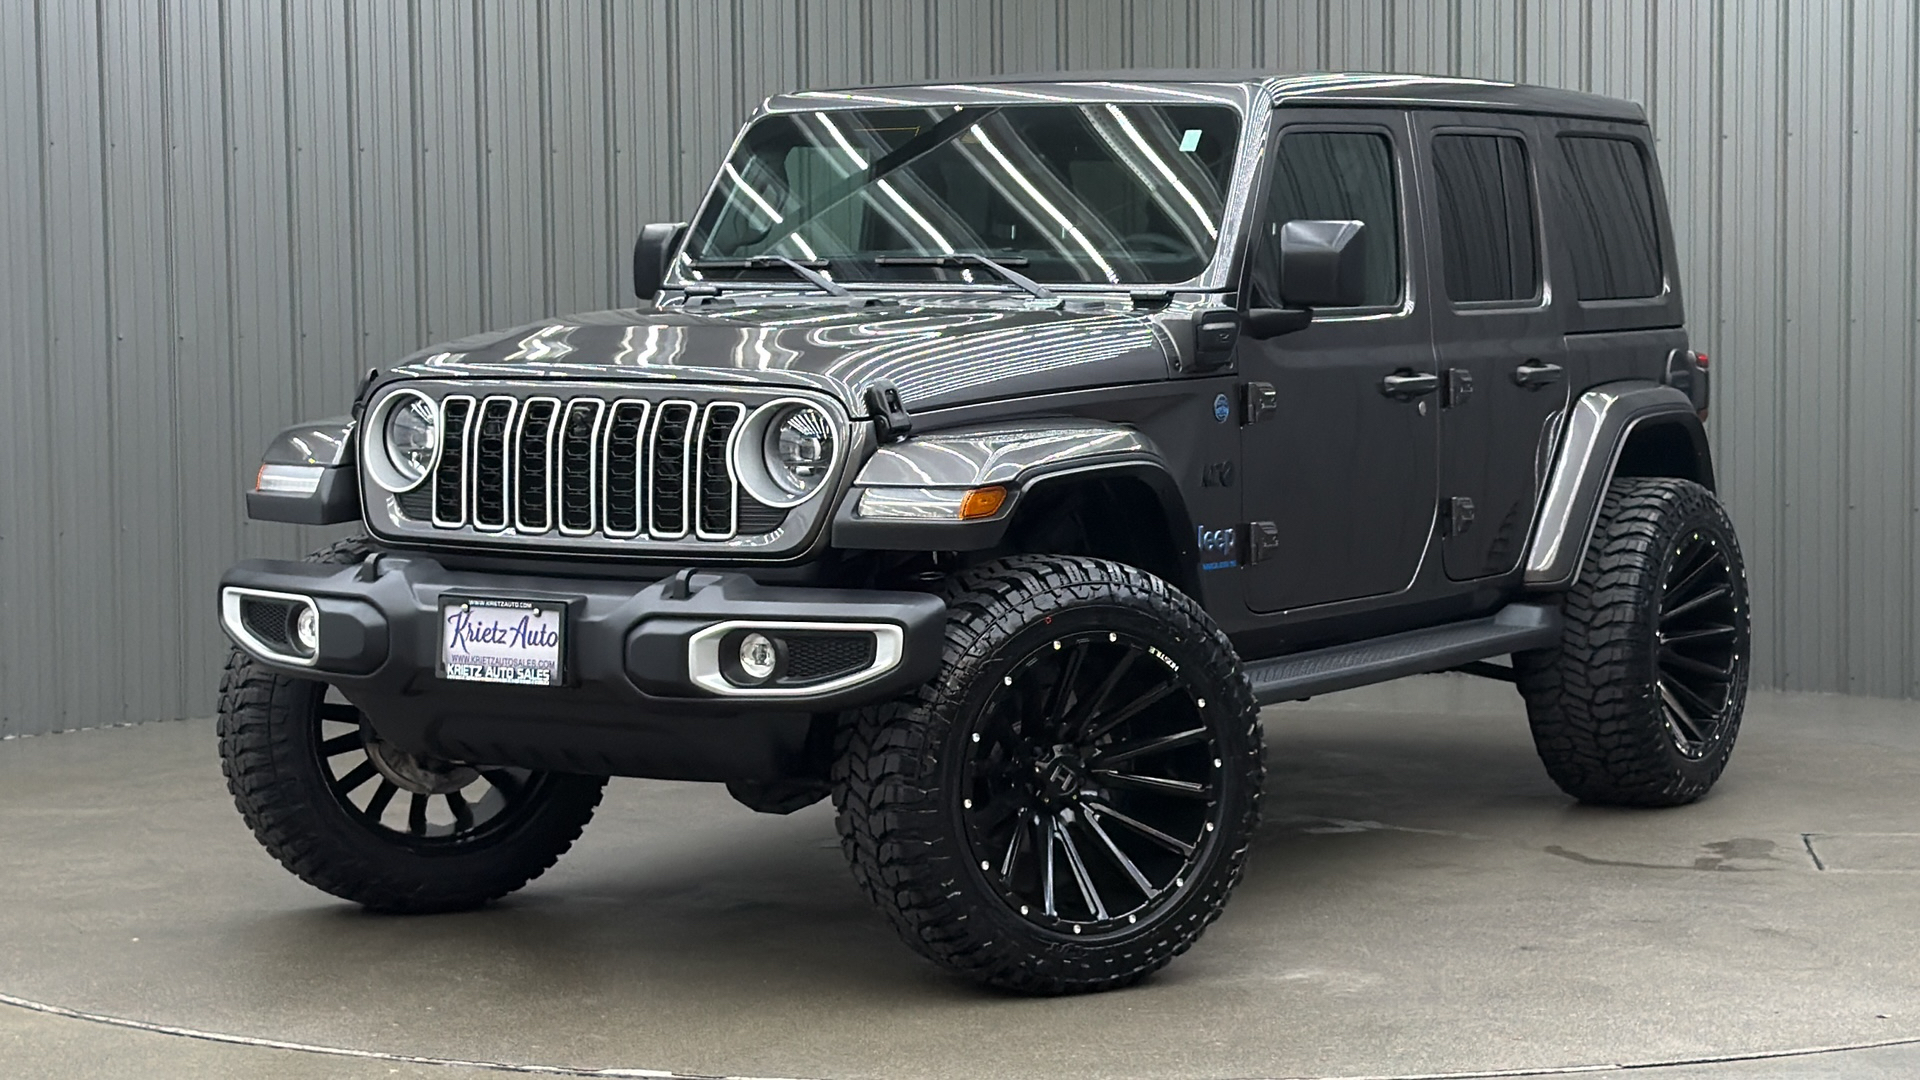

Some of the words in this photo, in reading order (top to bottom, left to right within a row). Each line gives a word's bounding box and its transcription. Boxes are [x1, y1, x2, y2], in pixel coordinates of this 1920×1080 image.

[1197, 525, 1235, 556] Jeep
[447, 610, 507, 655] Krietz
[510, 615, 558, 649] Auto
[447, 664, 482, 677] KRIETZ
[485, 667, 514, 679] AUTO
[517, 669, 549, 680] SALES
